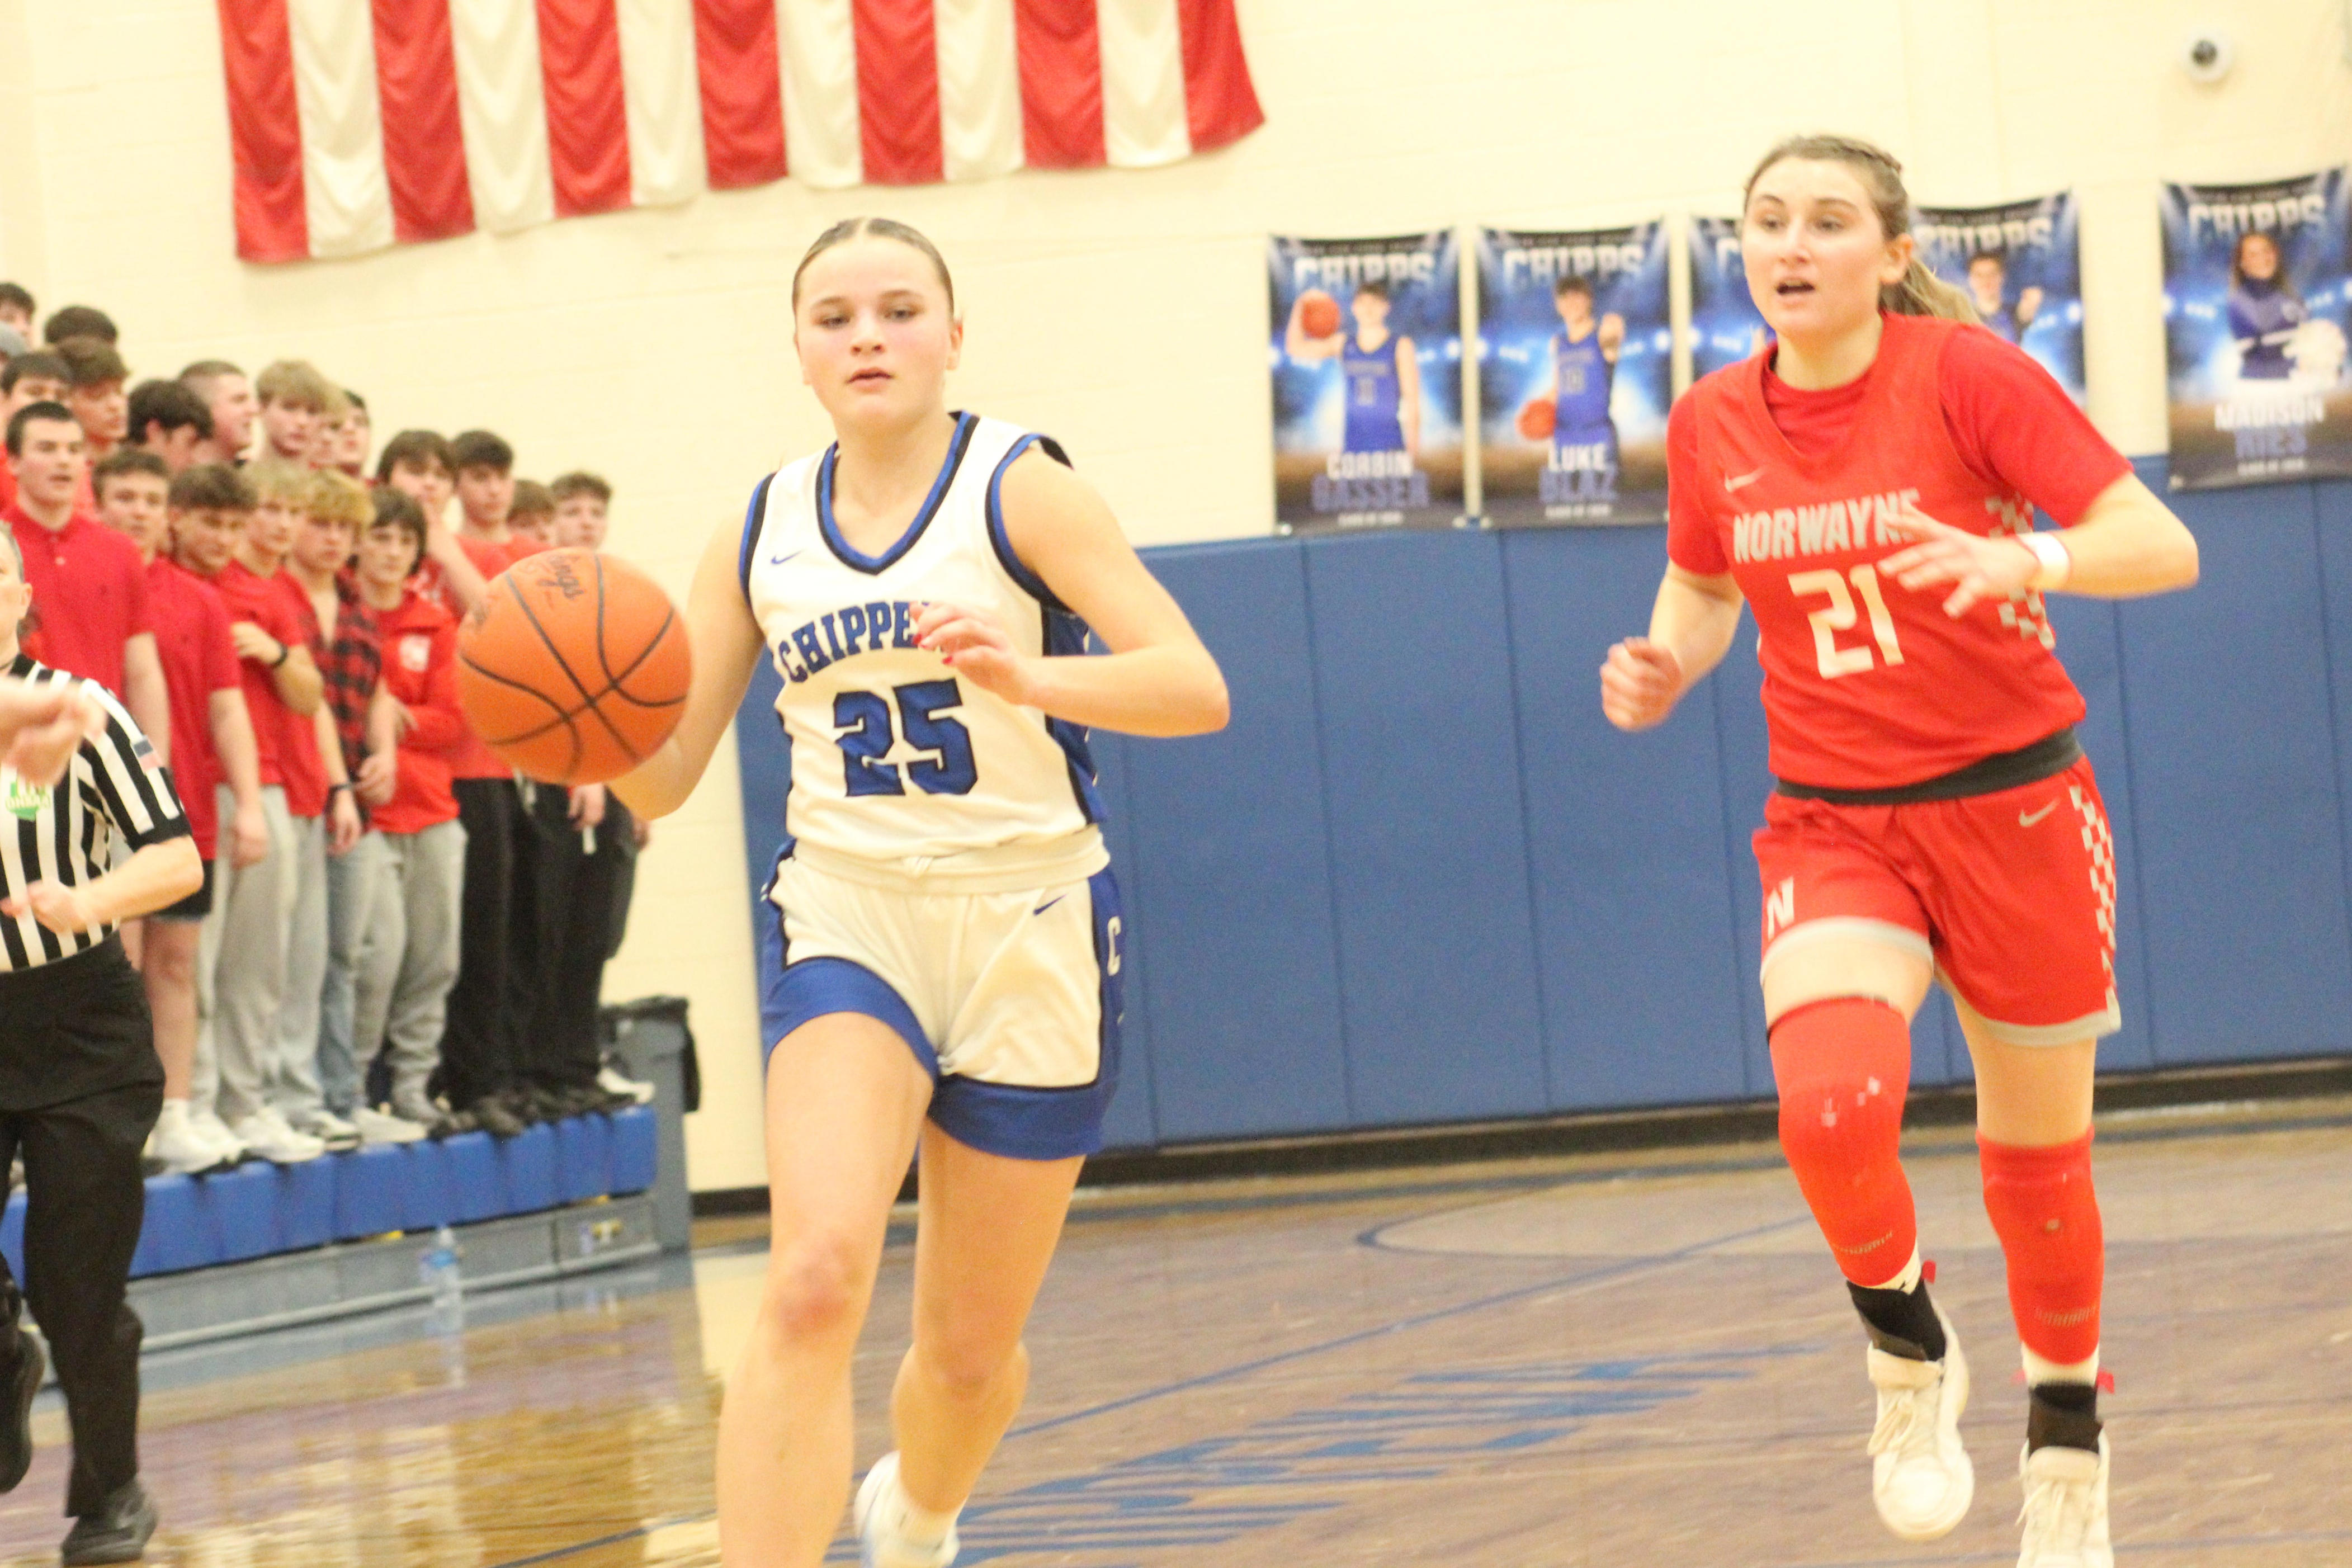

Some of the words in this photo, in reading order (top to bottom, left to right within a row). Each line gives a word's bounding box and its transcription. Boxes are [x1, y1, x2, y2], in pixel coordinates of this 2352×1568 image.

[778, 601, 931, 683] CHIPPE
[1788, 563, 1905, 680] 21
[833, 677, 978, 798] 25
[1767, 876, 1794, 941] N
